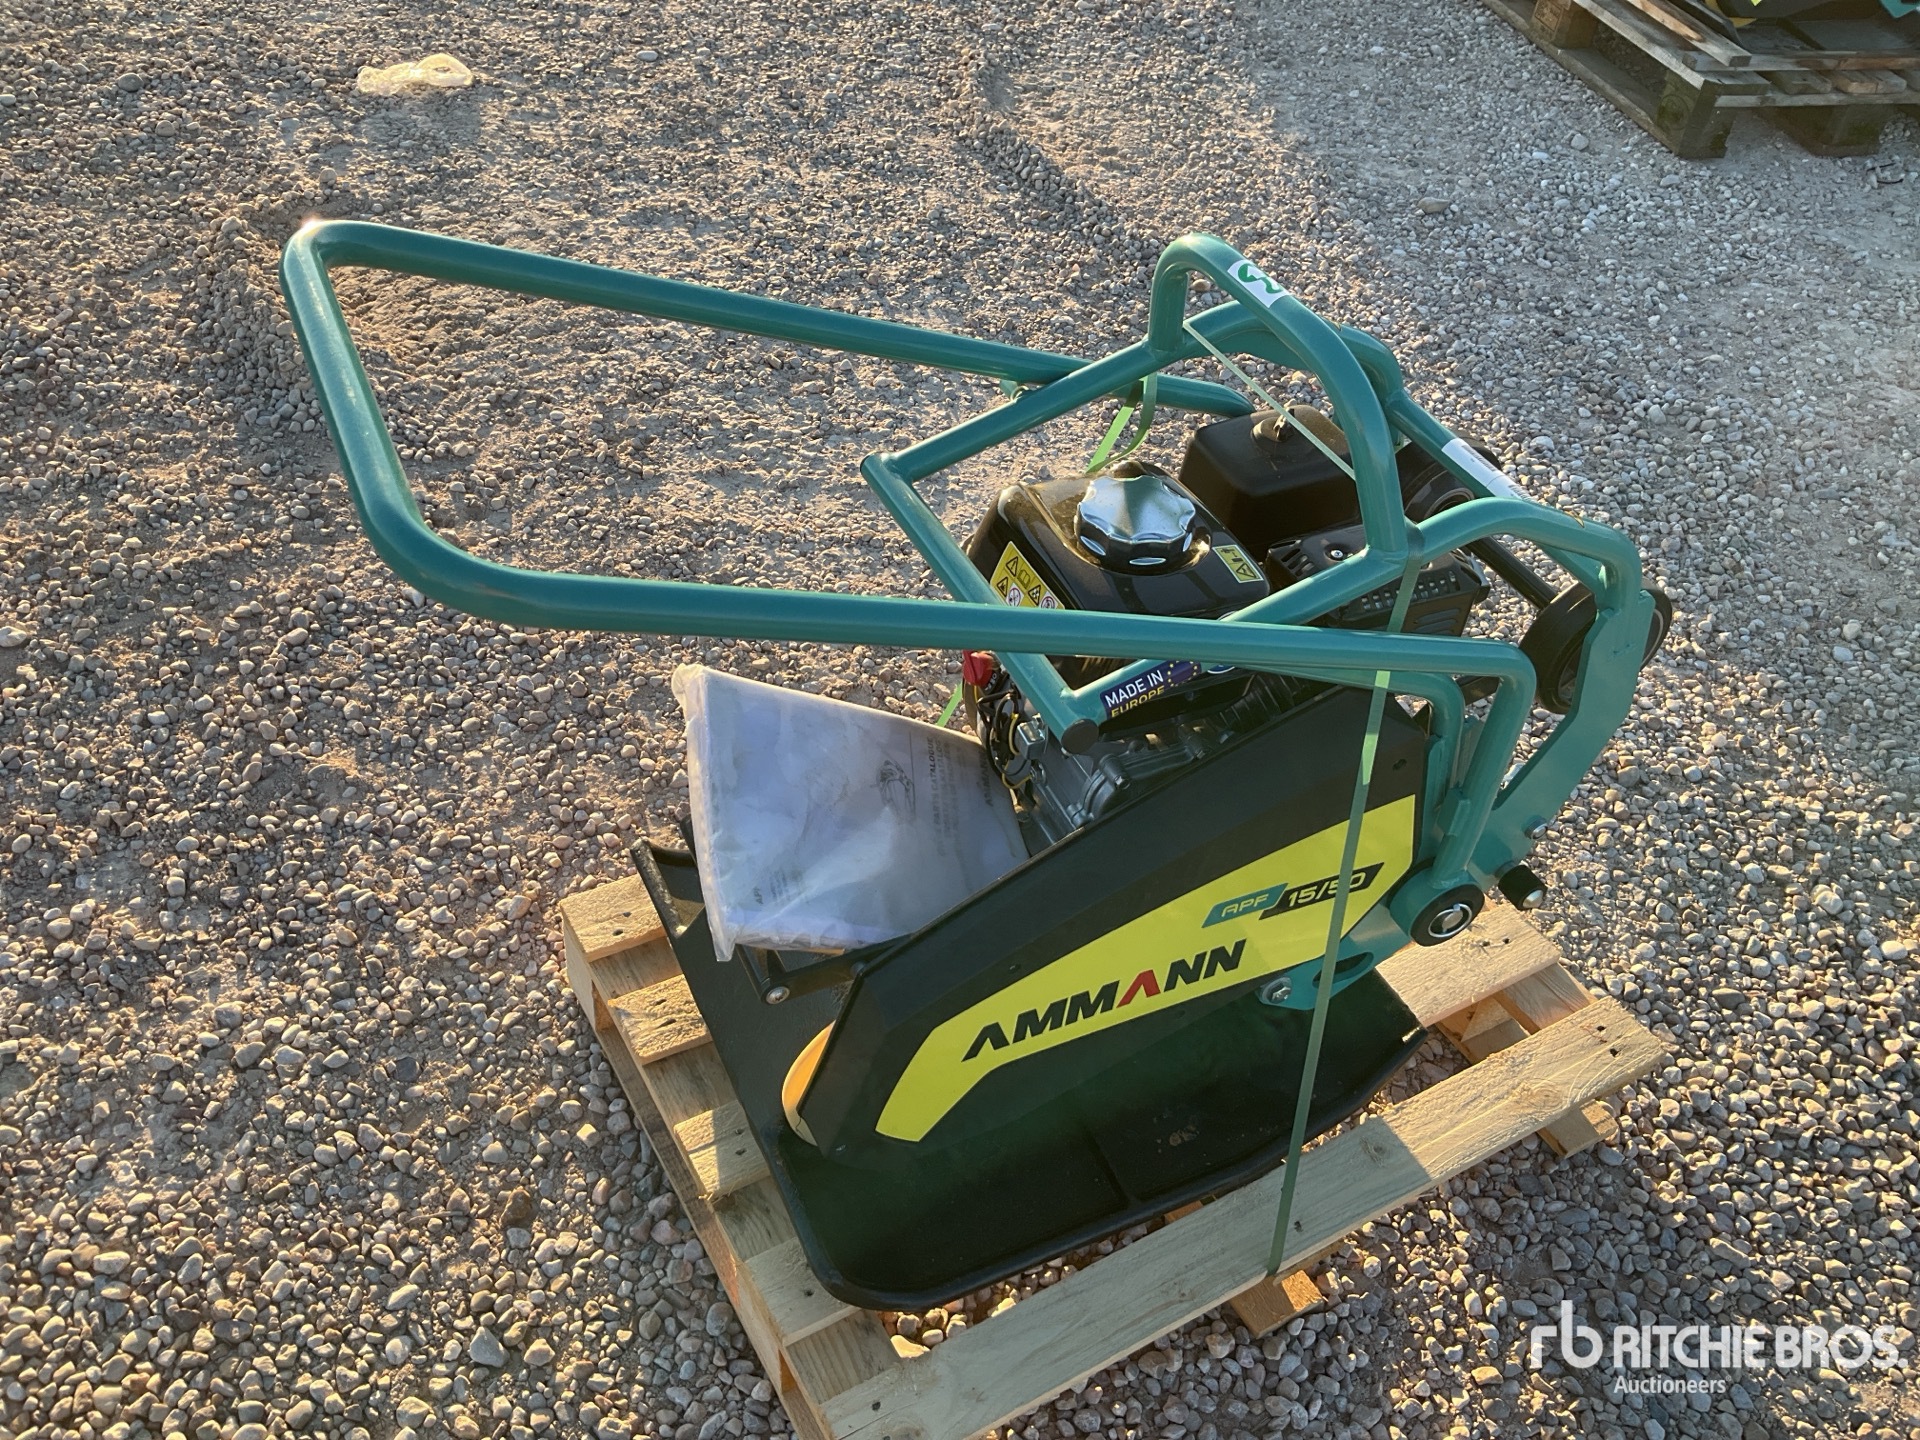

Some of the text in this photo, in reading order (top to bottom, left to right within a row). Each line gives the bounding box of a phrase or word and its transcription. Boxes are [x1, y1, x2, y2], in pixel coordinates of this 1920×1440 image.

[1105, 669, 1165, 708] MADE IN
[1111, 685, 1166, 718] EUROPE
[1221, 872, 1367, 917] APF 15/50
[961, 939, 1247, 1062] AMMANN
